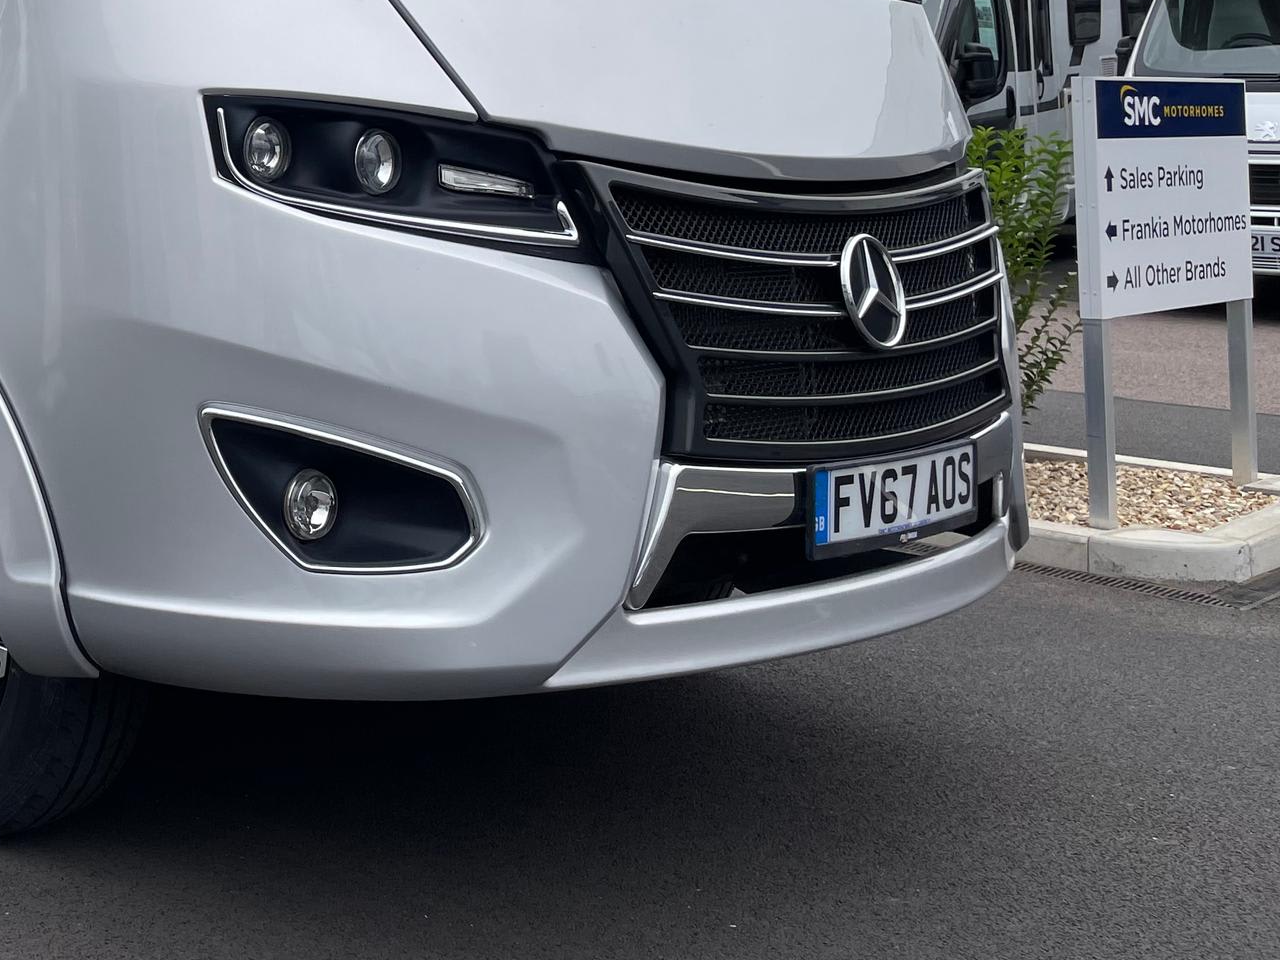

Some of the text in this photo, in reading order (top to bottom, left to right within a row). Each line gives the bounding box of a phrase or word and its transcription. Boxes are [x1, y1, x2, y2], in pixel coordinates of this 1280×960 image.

[1123, 95, 1225, 126] SMC MOTORHOMES
[1120, 164, 1204, 190] Sales Parking
[1122, 211, 1247, 241] Frankia Motorhomes
[1124, 256, 1226, 290] All Other Brands
[833, 452, 971, 534] FV67 AOS
